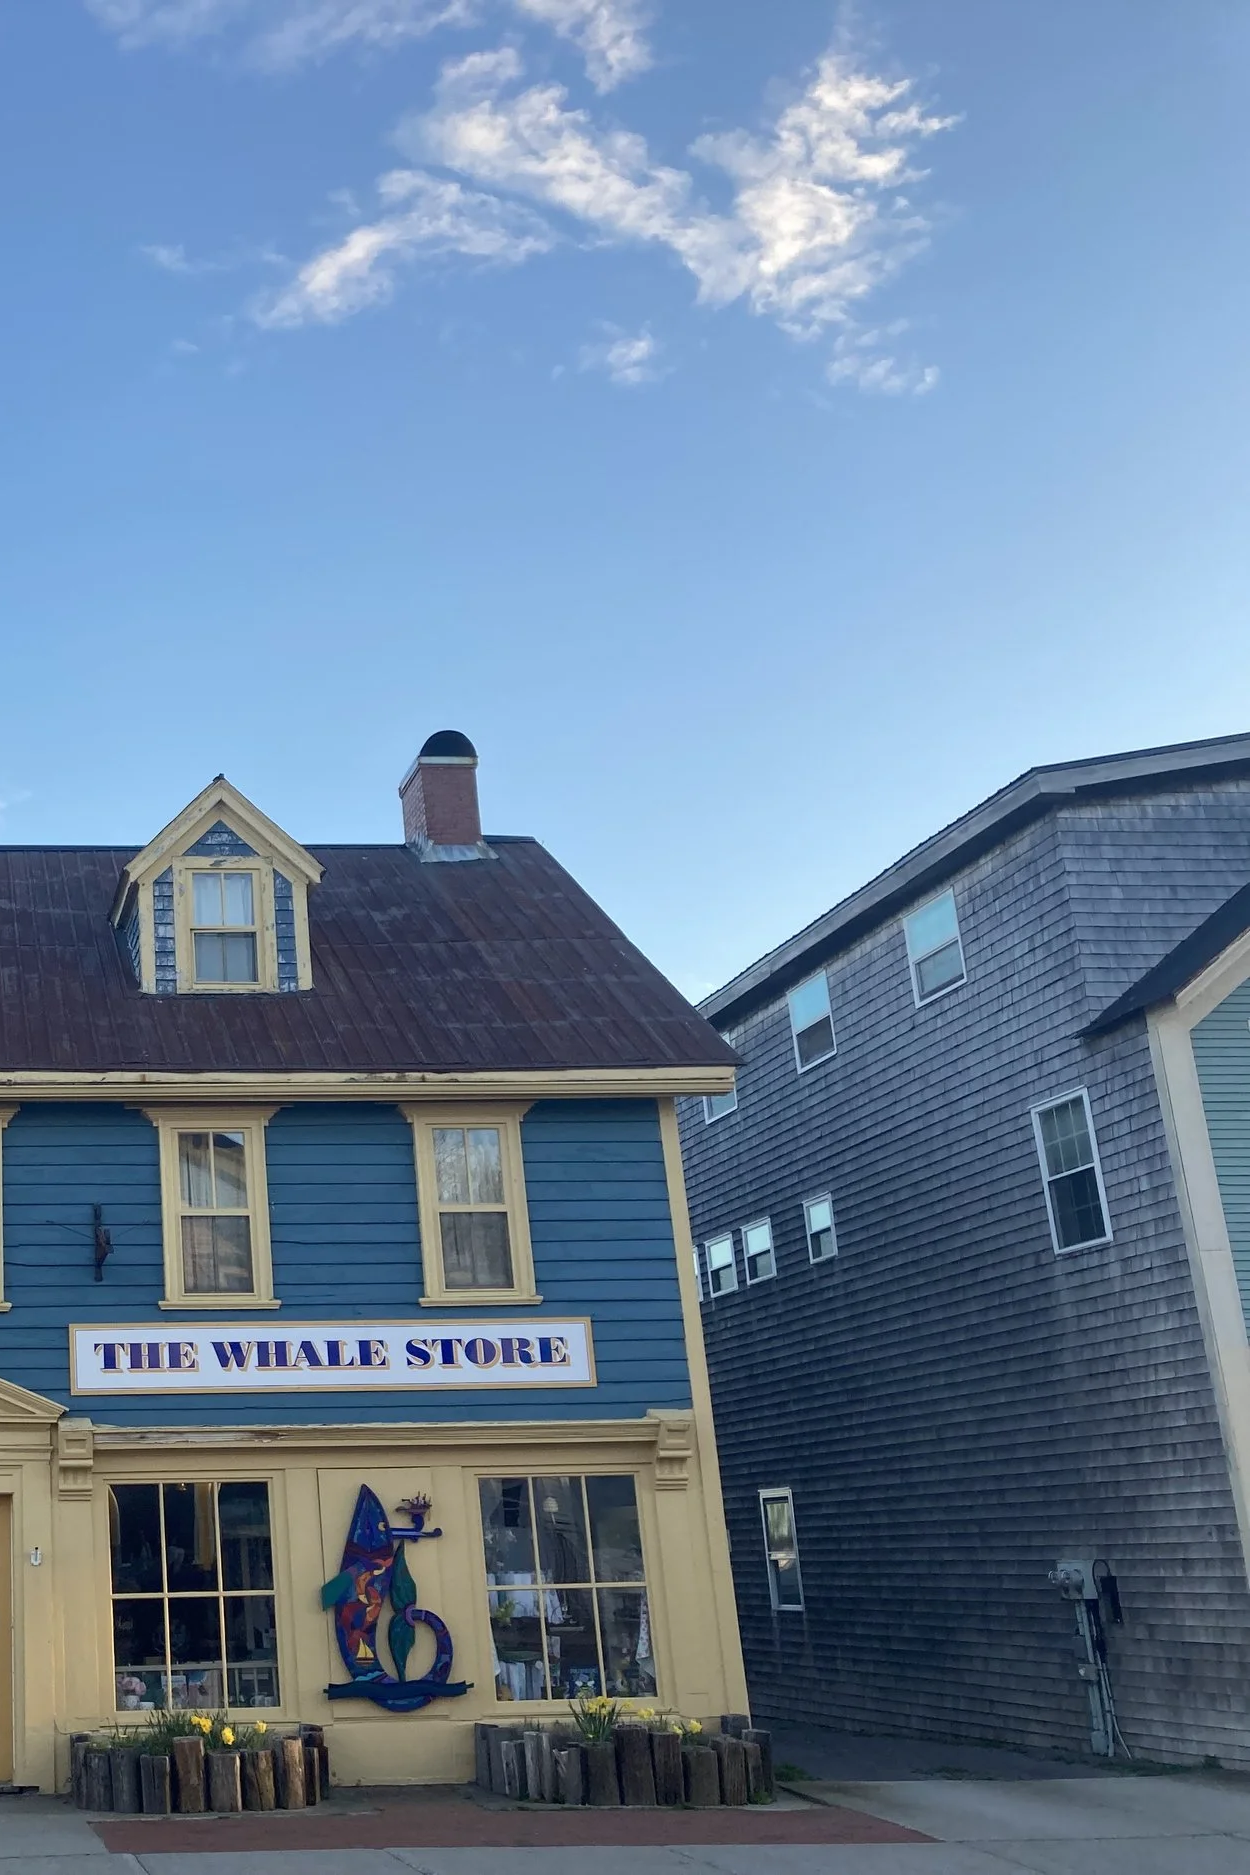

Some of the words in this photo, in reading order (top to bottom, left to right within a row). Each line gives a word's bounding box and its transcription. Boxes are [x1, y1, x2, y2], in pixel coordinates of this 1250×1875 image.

[94, 1341, 199, 1373] THE
[209, 1339, 391, 1372] WHALE
[405, 1336, 571, 1369] STORE
